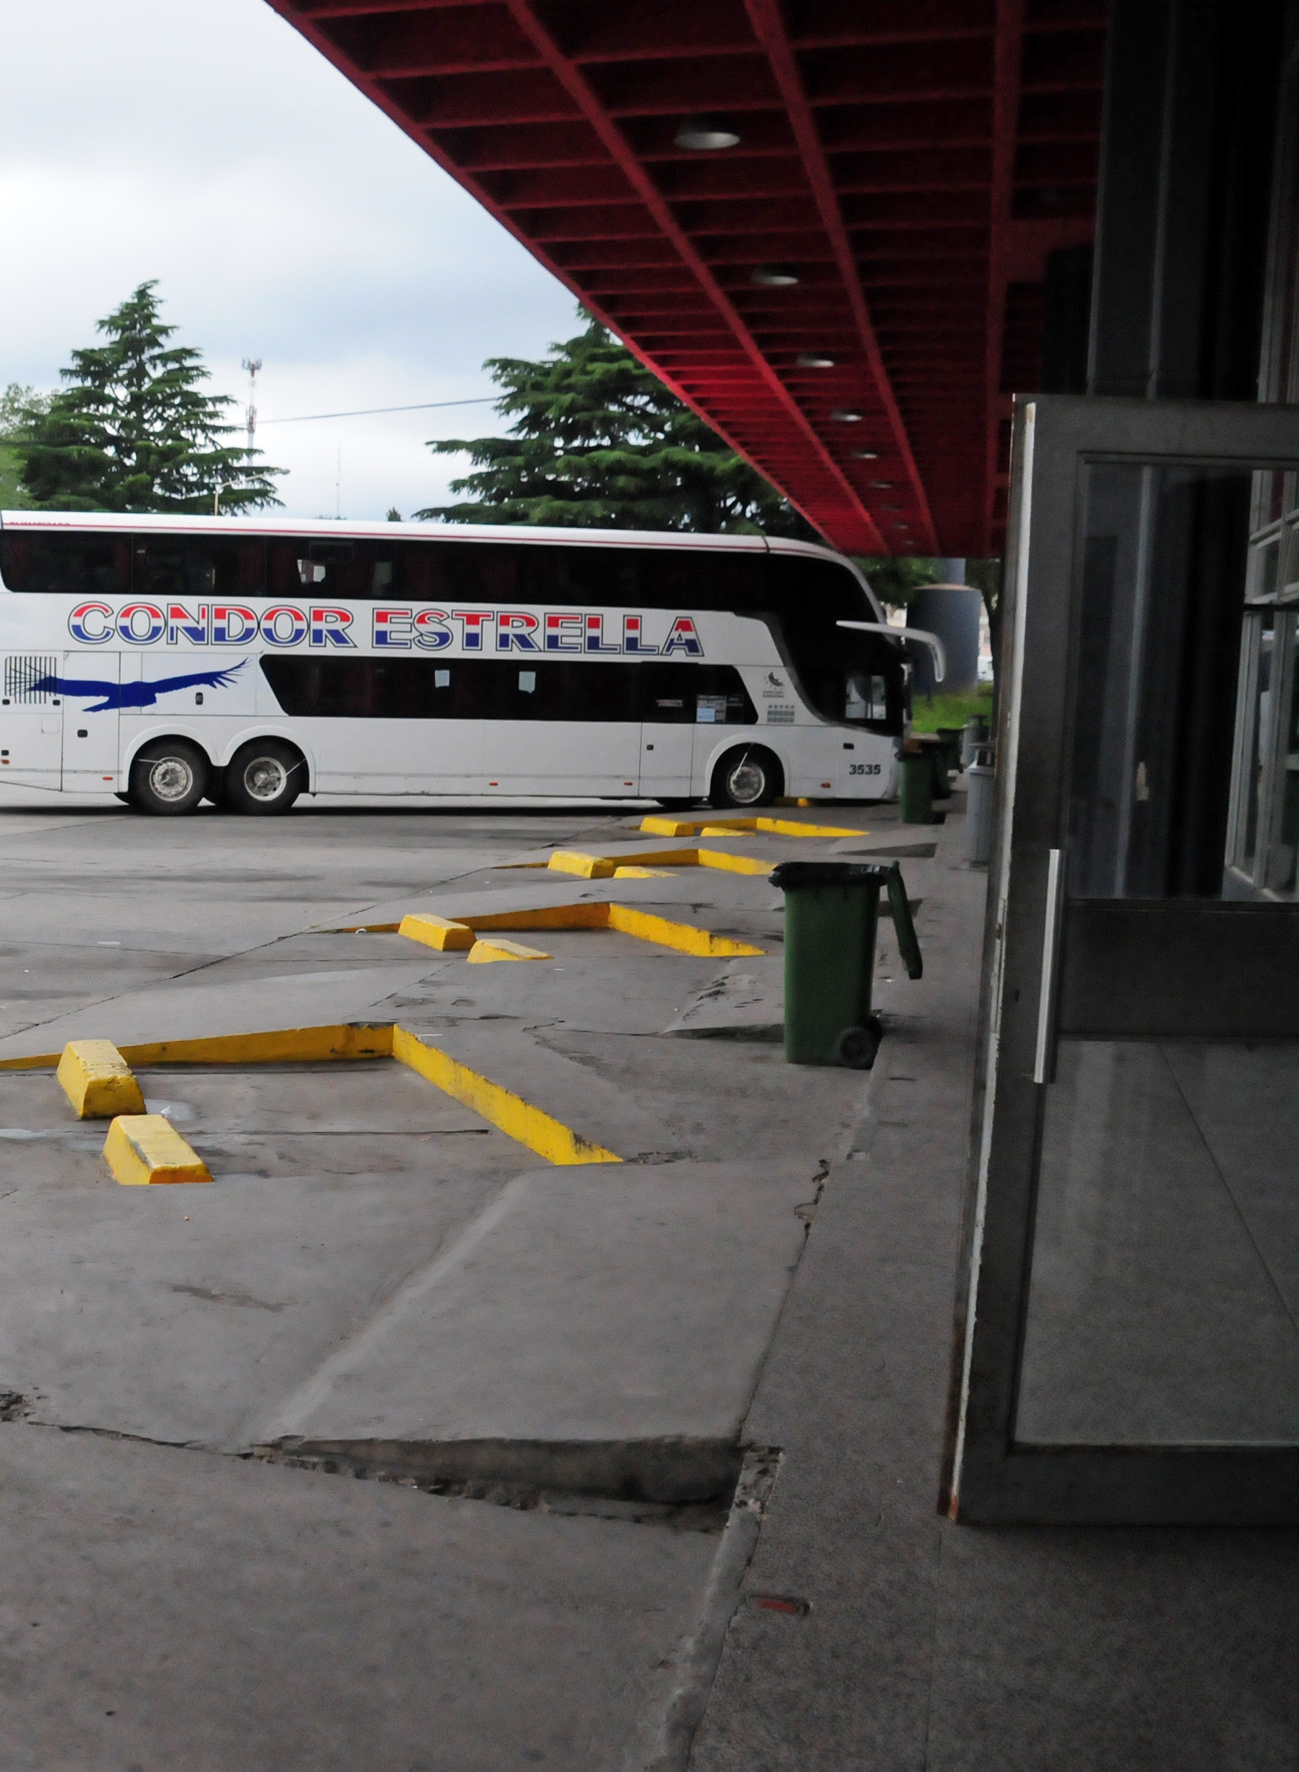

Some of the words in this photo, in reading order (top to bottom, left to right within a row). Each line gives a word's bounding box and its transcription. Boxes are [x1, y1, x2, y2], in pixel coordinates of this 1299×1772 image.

[67, 600, 357, 648] CONDOR
[372, 607, 704, 657] ESTRELLA
[849, 763, 881, 775] 3535
